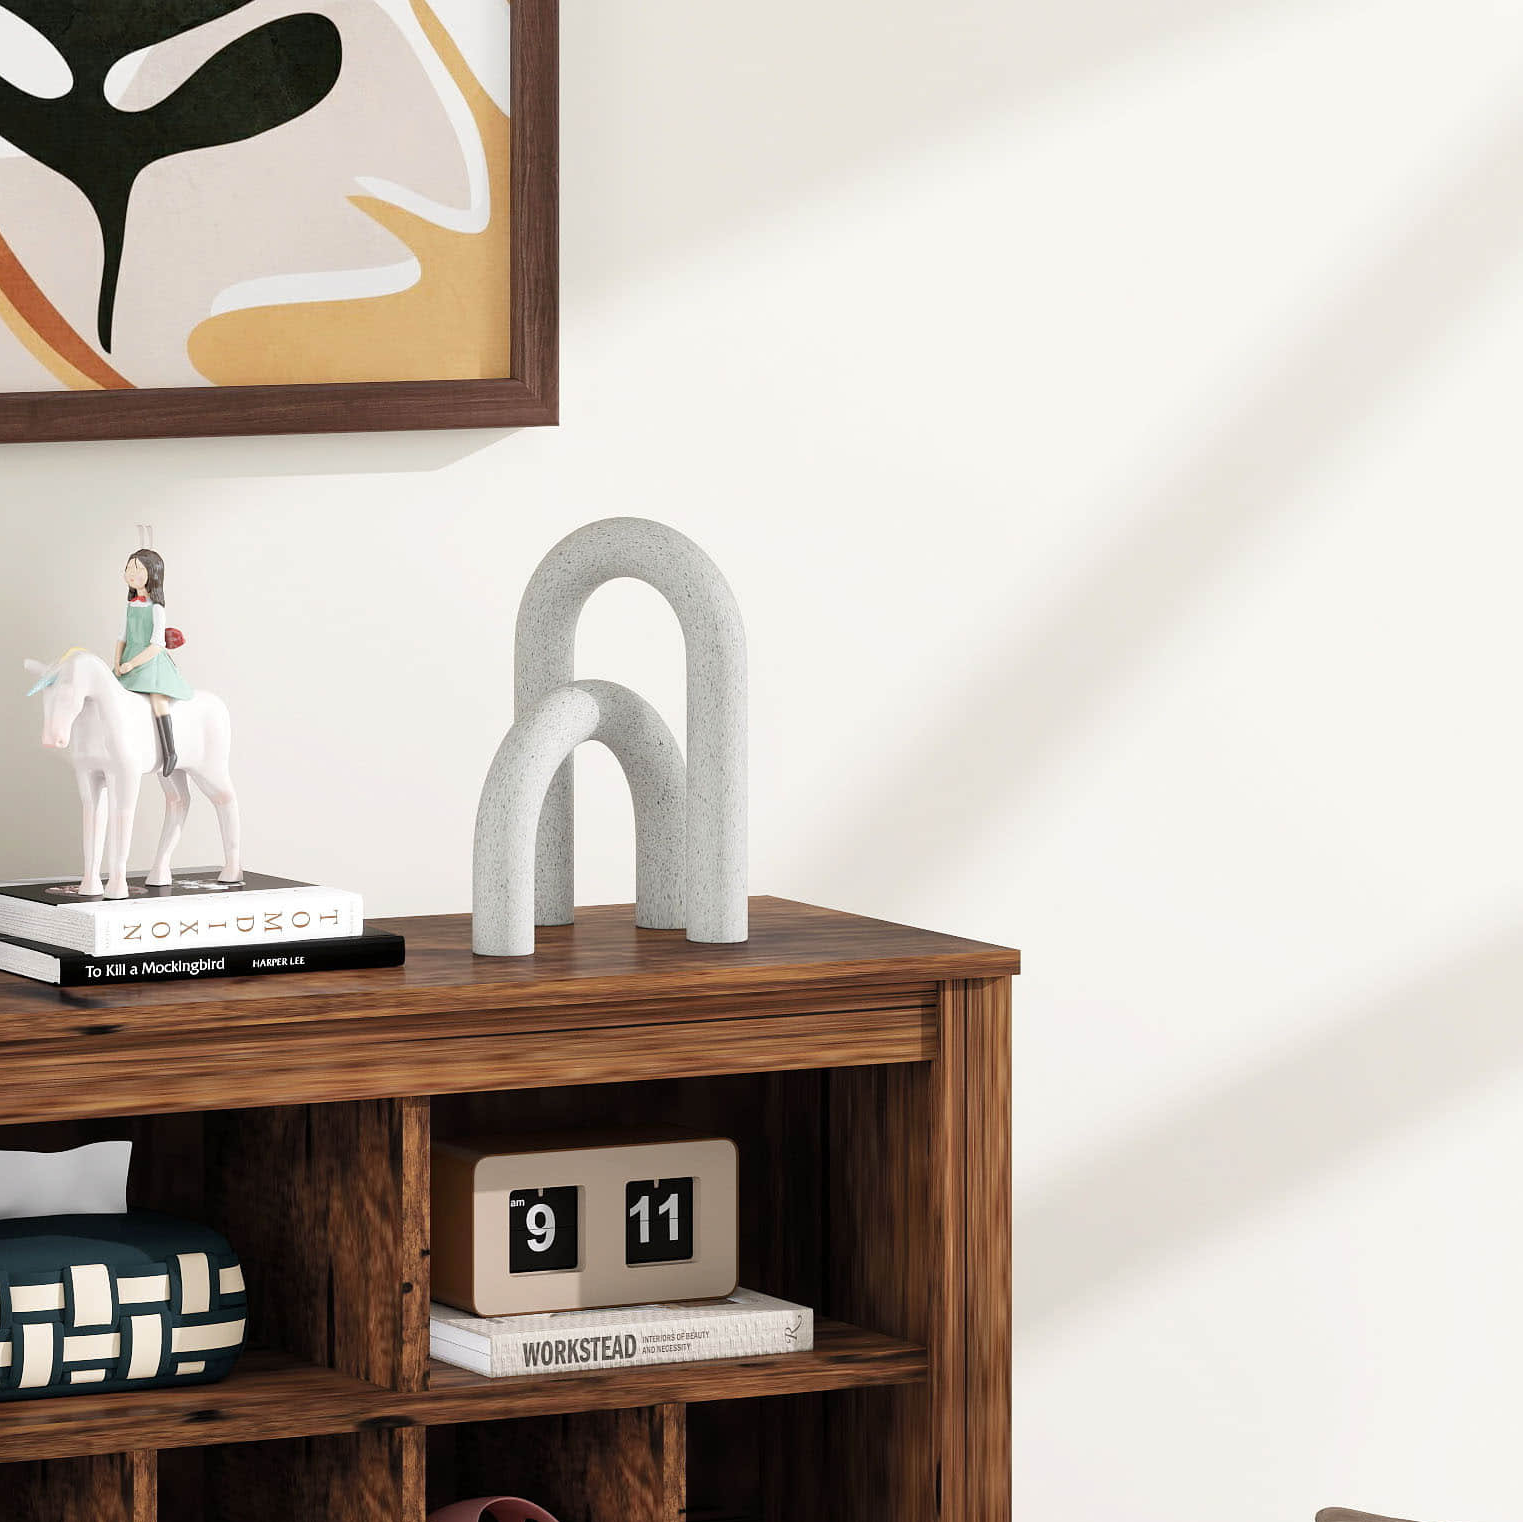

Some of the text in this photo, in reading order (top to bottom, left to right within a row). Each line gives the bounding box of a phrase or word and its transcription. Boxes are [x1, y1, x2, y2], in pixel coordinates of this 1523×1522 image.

[85, 957, 225, 978] To Kill a Mockingbird
[252, 956, 306, 968] HARPER LEE
[510, 1198, 556, 1253] am 9
[629, 1193, 679, 1244] 11
[642, 1330, 710, 1344] INTERIORS OF BEAUTY
[522, 1333, 638, 1368] WORKSTEAD
[642, 1343, 691, 1354] AND NECESSITY
